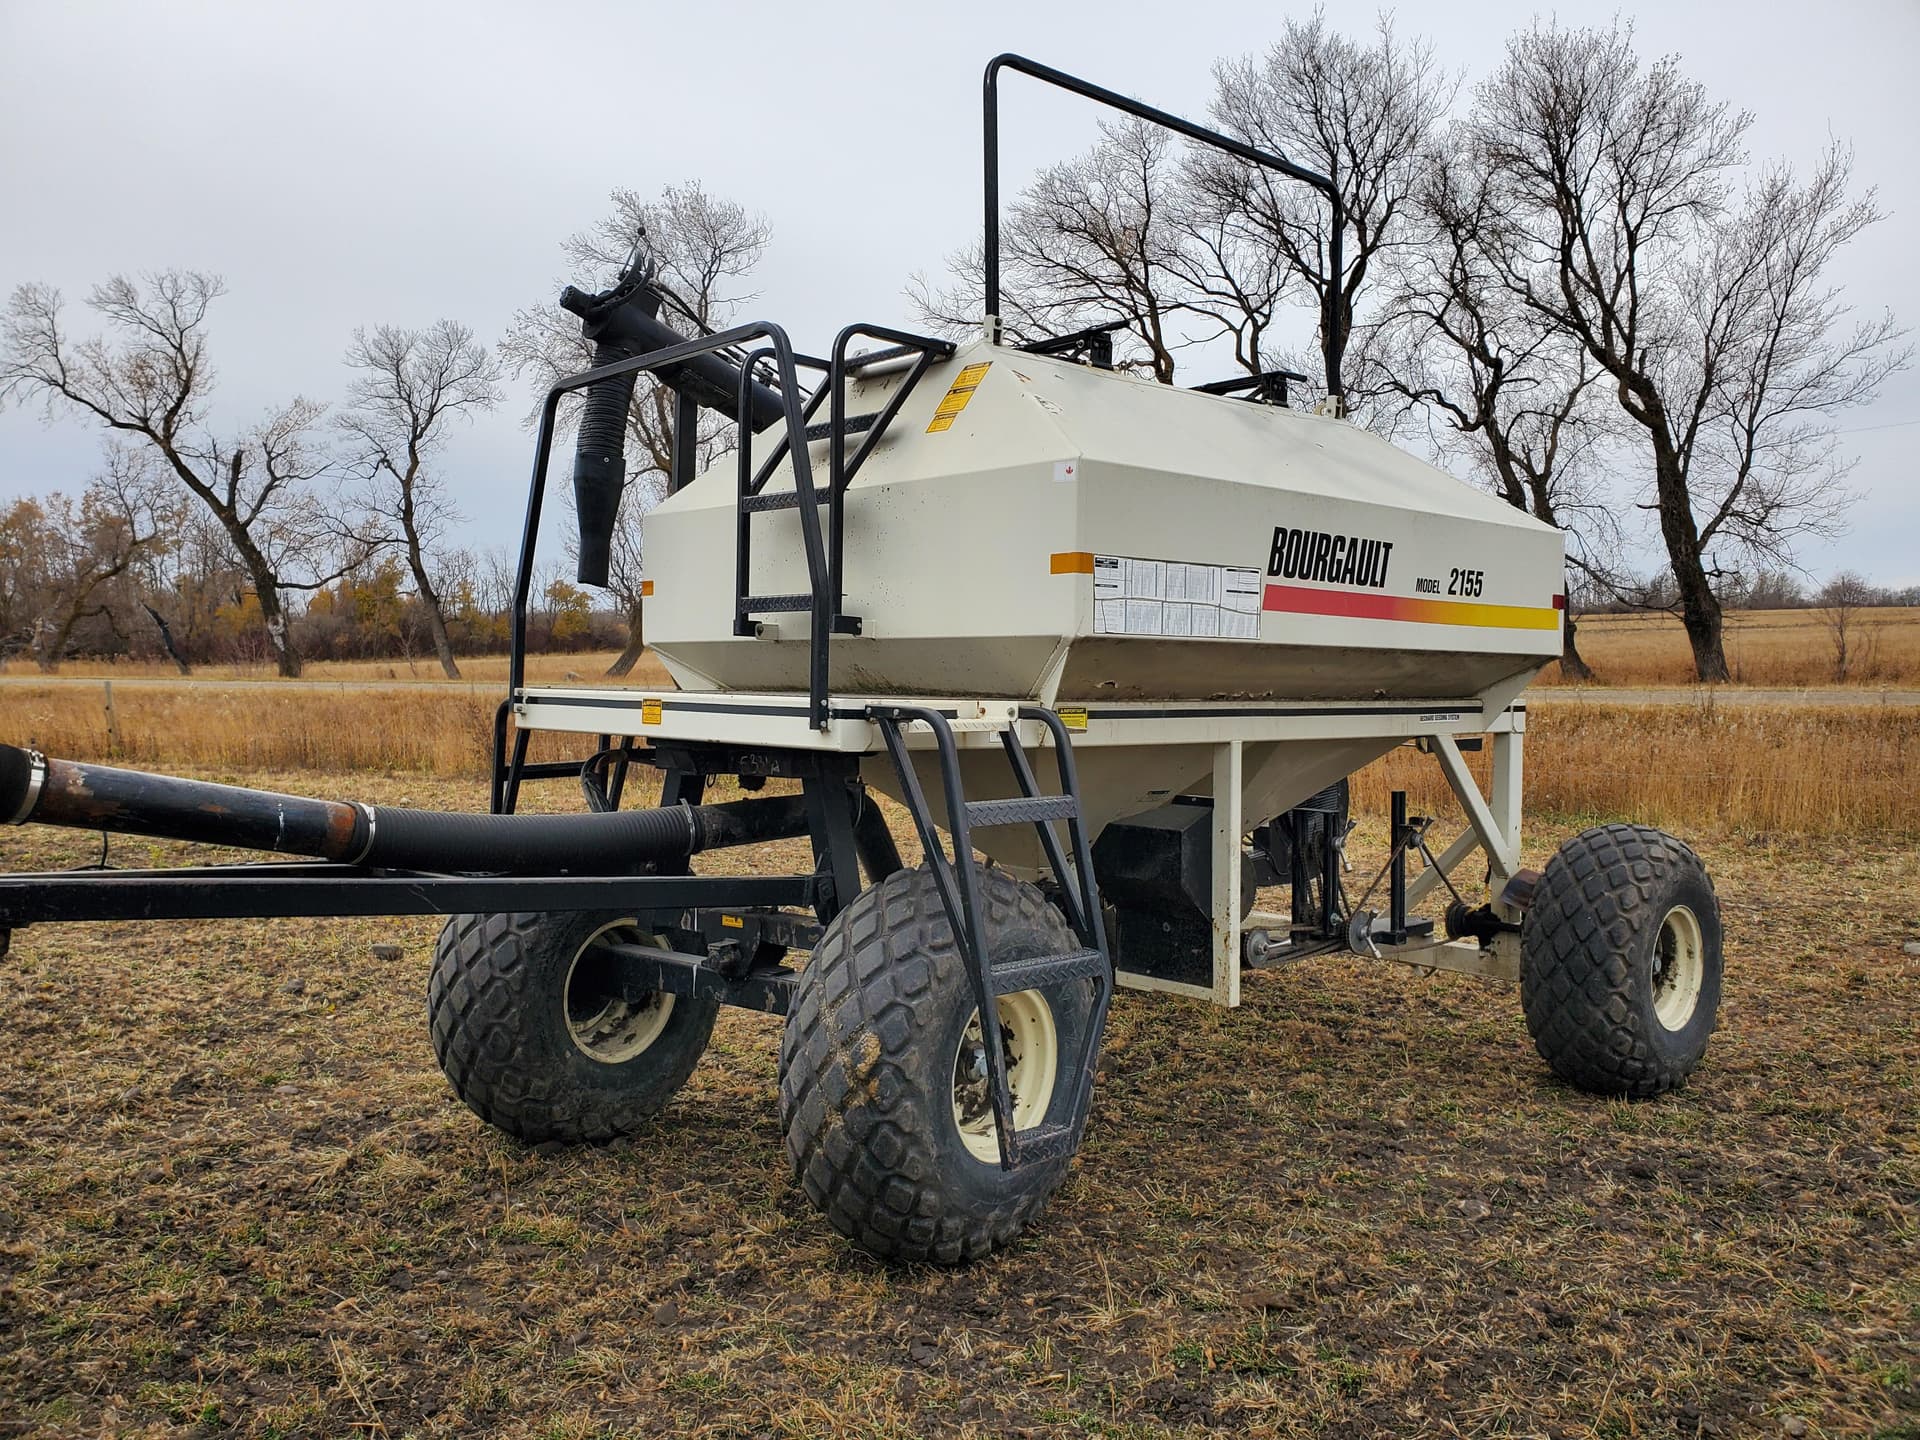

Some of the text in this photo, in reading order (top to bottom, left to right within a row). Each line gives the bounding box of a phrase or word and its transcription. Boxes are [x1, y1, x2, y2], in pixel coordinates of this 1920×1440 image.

[1267, 526, 1393, 588] BOURGAULT
[1415, 567, 1484, 597] MODEL 2155
